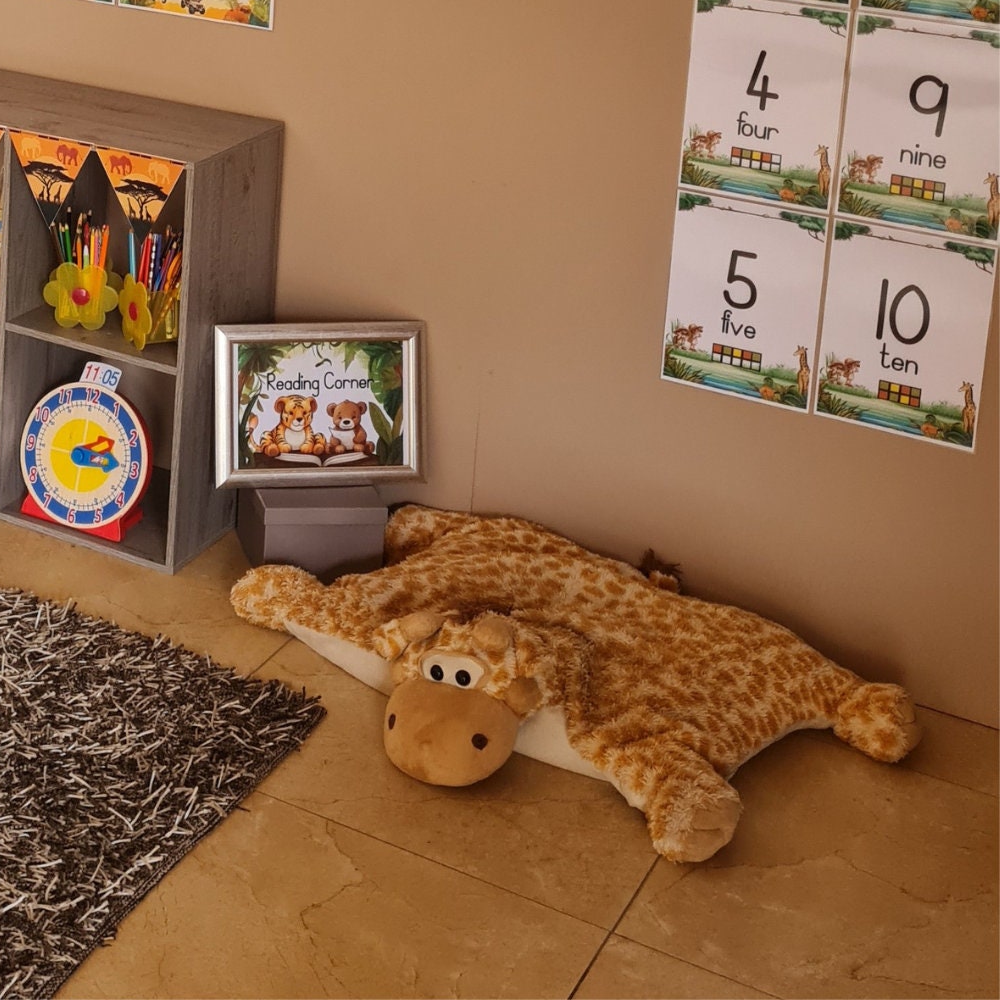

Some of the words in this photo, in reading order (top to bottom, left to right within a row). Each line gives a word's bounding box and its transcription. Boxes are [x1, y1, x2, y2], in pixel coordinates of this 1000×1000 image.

[745, 49, 780, 112] 4
[908, 74, 950, 139] 9
[735, 109, 780, 142] four
[898, 145, 947, 170] nine
[722, 249, 758, 311] 5
[874, 277, 931, 346] 10
[720, 309, 757, 340] five
[878, 341, 919, 377] ten
[84, 364, 121, 387] 11:05
[266, 371, 320, 397] Reading
[323, 371, 375, 390] Corner
[58, 387, 72, 405] 11
[85, 387, 100, 405] 12
[35, 406, 50, 423] 10
[113, 402, 120, 417] 1
[27, 435, 36, 451] 9
[129, 430, 138, 447] 2
[28, 466, 38, 483] 8
[130, 462, 139, 479] 3
[43, 493, 51, 509] 7
[115, 492, 125, 508] 4
[66, 508, 76, 524] 6
[93, 508, 102, 524] 5
